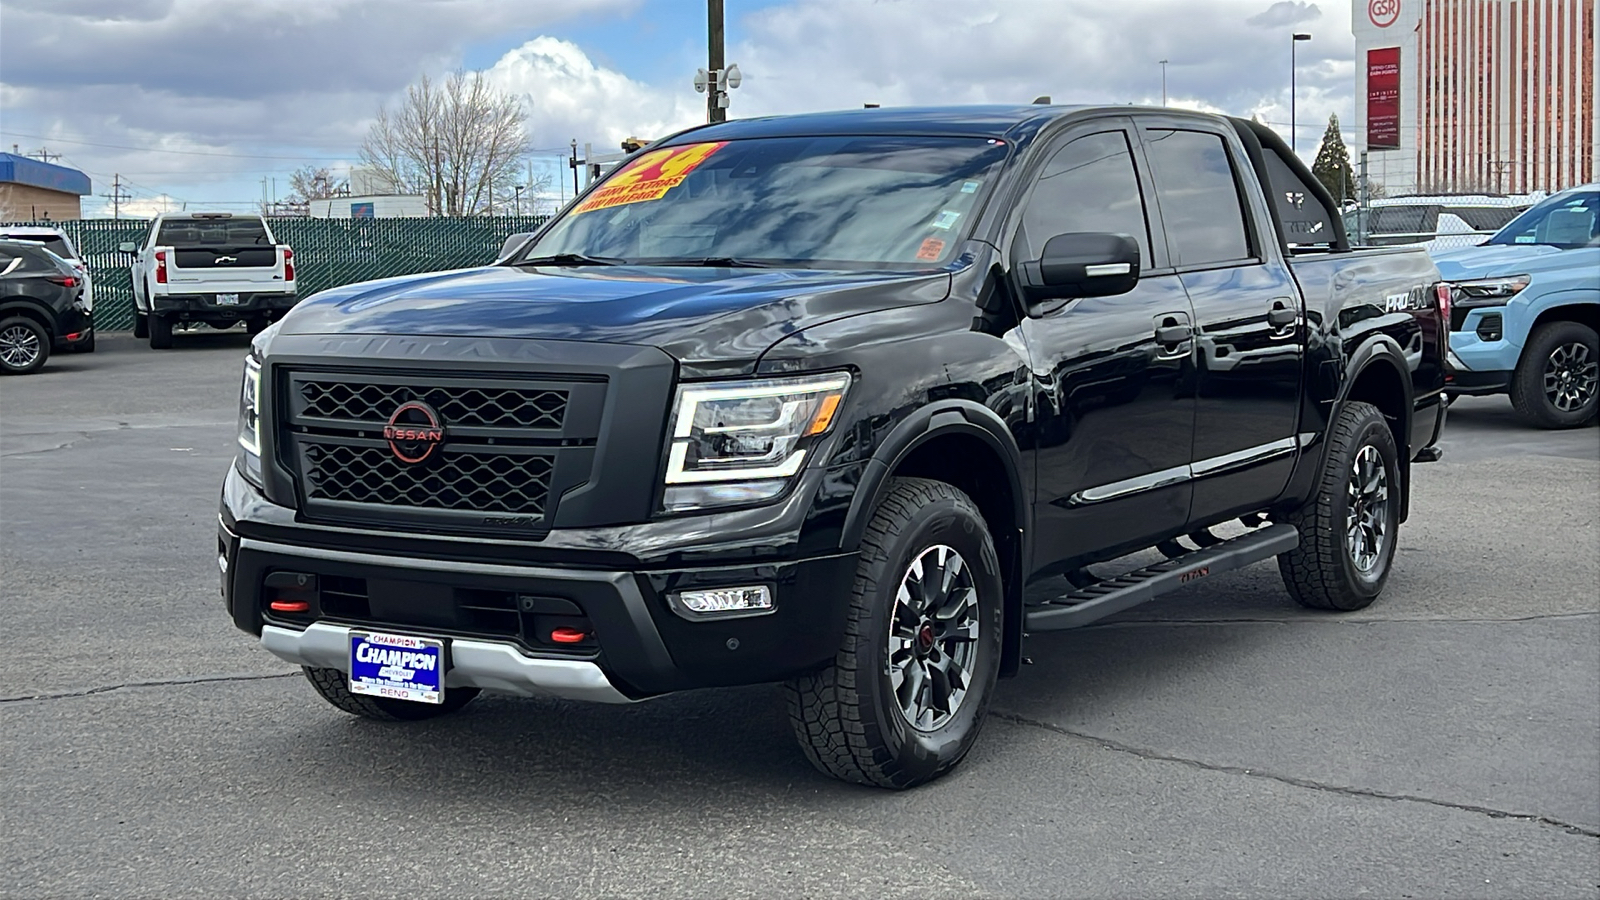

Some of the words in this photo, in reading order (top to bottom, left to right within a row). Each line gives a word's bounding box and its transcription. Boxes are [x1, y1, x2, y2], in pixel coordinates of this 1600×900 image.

[1372, 0, 1395, 16] GSR
[592, 185, 629, 199] MANY
[628, 177, 683, 192] EXTRAS
[576, 198, 605, 214] LOW
[603, 189, 664, 206] MILEAGE
[319, 337, 560, 360] TITAN
[383, 426, 442, 441] NISSAN
[373, 635, 417, 647] CHAMPION
[356, 642, 436, 671] CHAMPION
[382, 668, 412, 677] CHEVROLET
[380, 688, 409, 698] RENO
